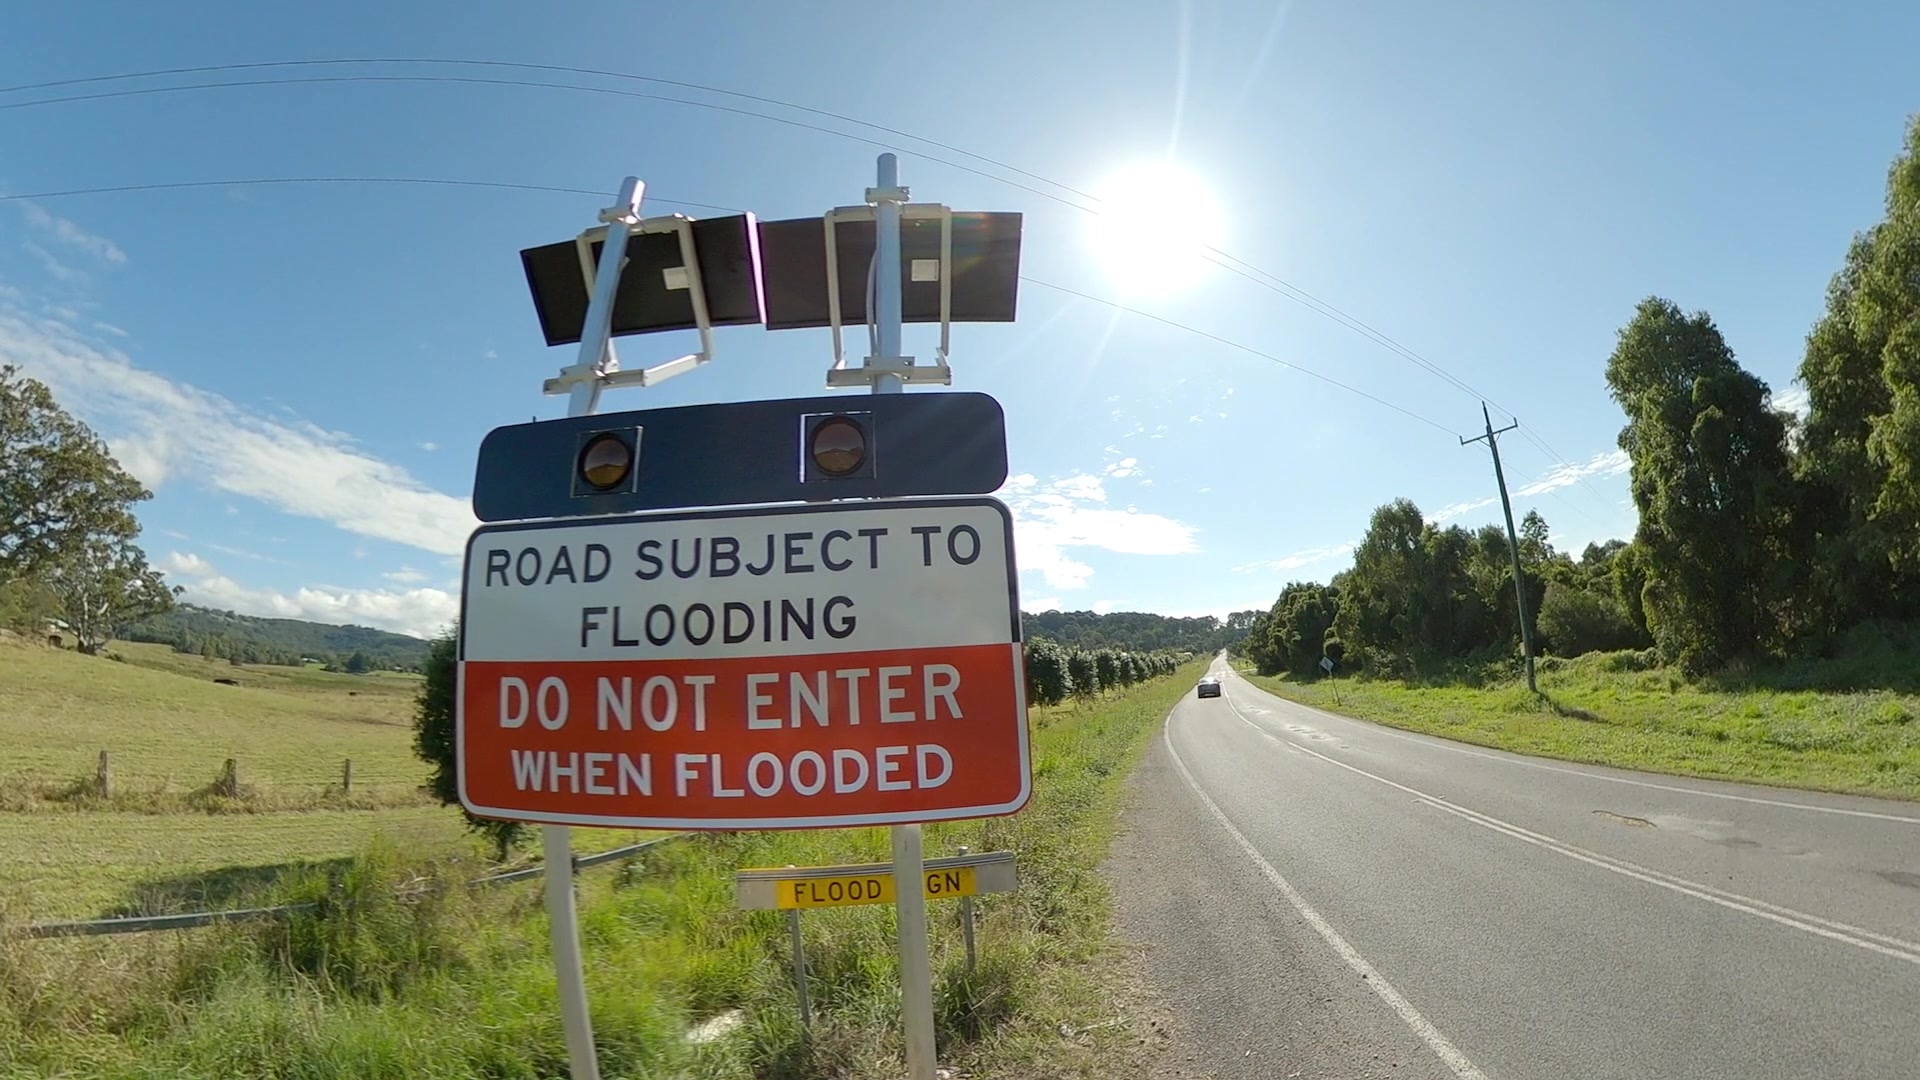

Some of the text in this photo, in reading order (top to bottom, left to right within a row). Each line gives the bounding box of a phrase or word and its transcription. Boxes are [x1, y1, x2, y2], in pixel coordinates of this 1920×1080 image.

[486, 524, 980, 587] ROAD SUBJECT TO
[580, 596, 856, 648] FLOODING
[500, 664, 963, 731] DO NOT ENTER
[511, 744, 953, 797] WHEN FLOODED
[794, 879, 881, 903] FLOOD
